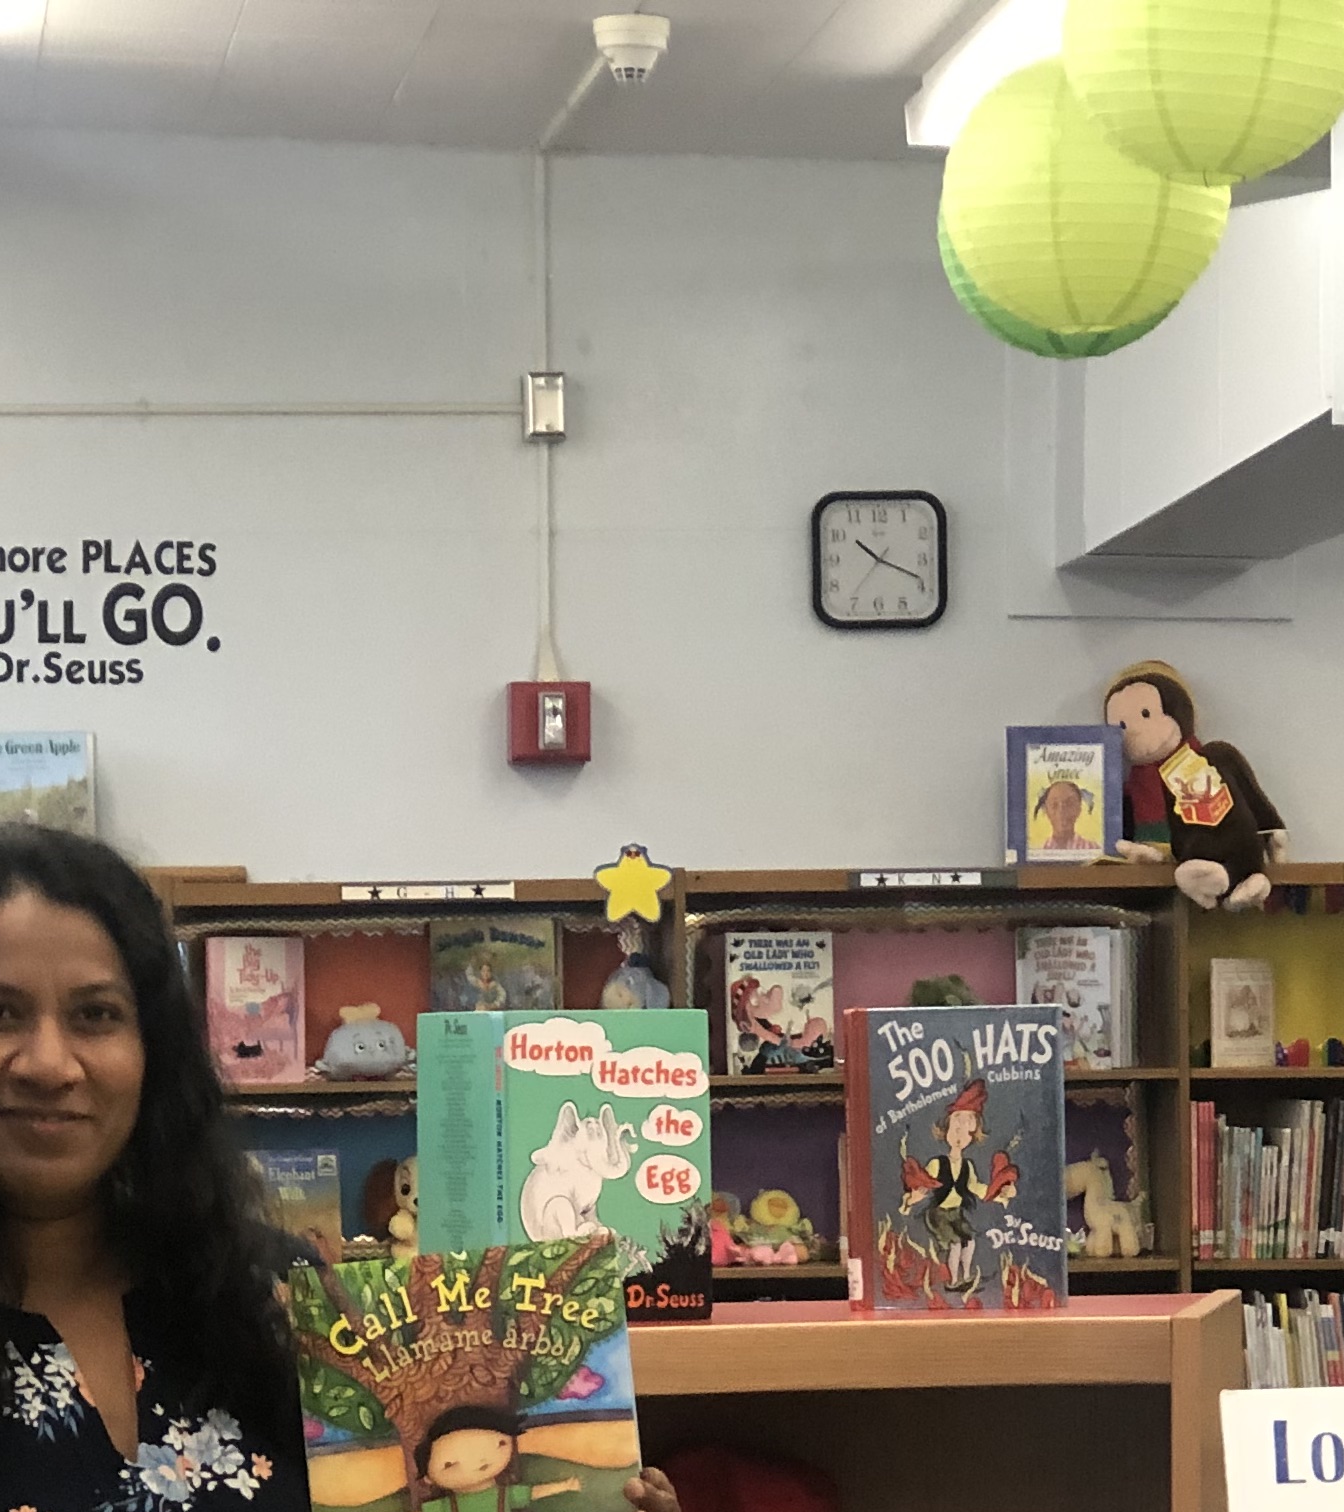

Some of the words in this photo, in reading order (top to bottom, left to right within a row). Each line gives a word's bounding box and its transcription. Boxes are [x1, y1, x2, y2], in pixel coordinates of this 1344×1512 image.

[81, 539, 218, 577] PLACES
[102, 581, 221, 652] GO.
[5, 740, 43, 755] Green
[1034, 746, 1095, 767] Amazing
[510, 1033, 593, 1062] Horton
[877, 1020, 924, 1052] The
[972, 1019, 1058, 1069] HATS
[599, 1060, 697, 1087] Hatches
[887, 1038, 955, 1101] 500
[987, 1068, 1041, 1083] Cubbins
[655, 1110, 694, 1136] the
[875, 1116, 888, 1134] of
[887, 1082, 957, 1124] Bartholomew
[646, 1165, 691, 1195] Egg
[1019, 1226, 1064, 1253] Seuss
[329, 1286, 418, 1355] Call
[431, 1272, 492, 1313] Me
[512, 1272, 600, 1330] Tree
